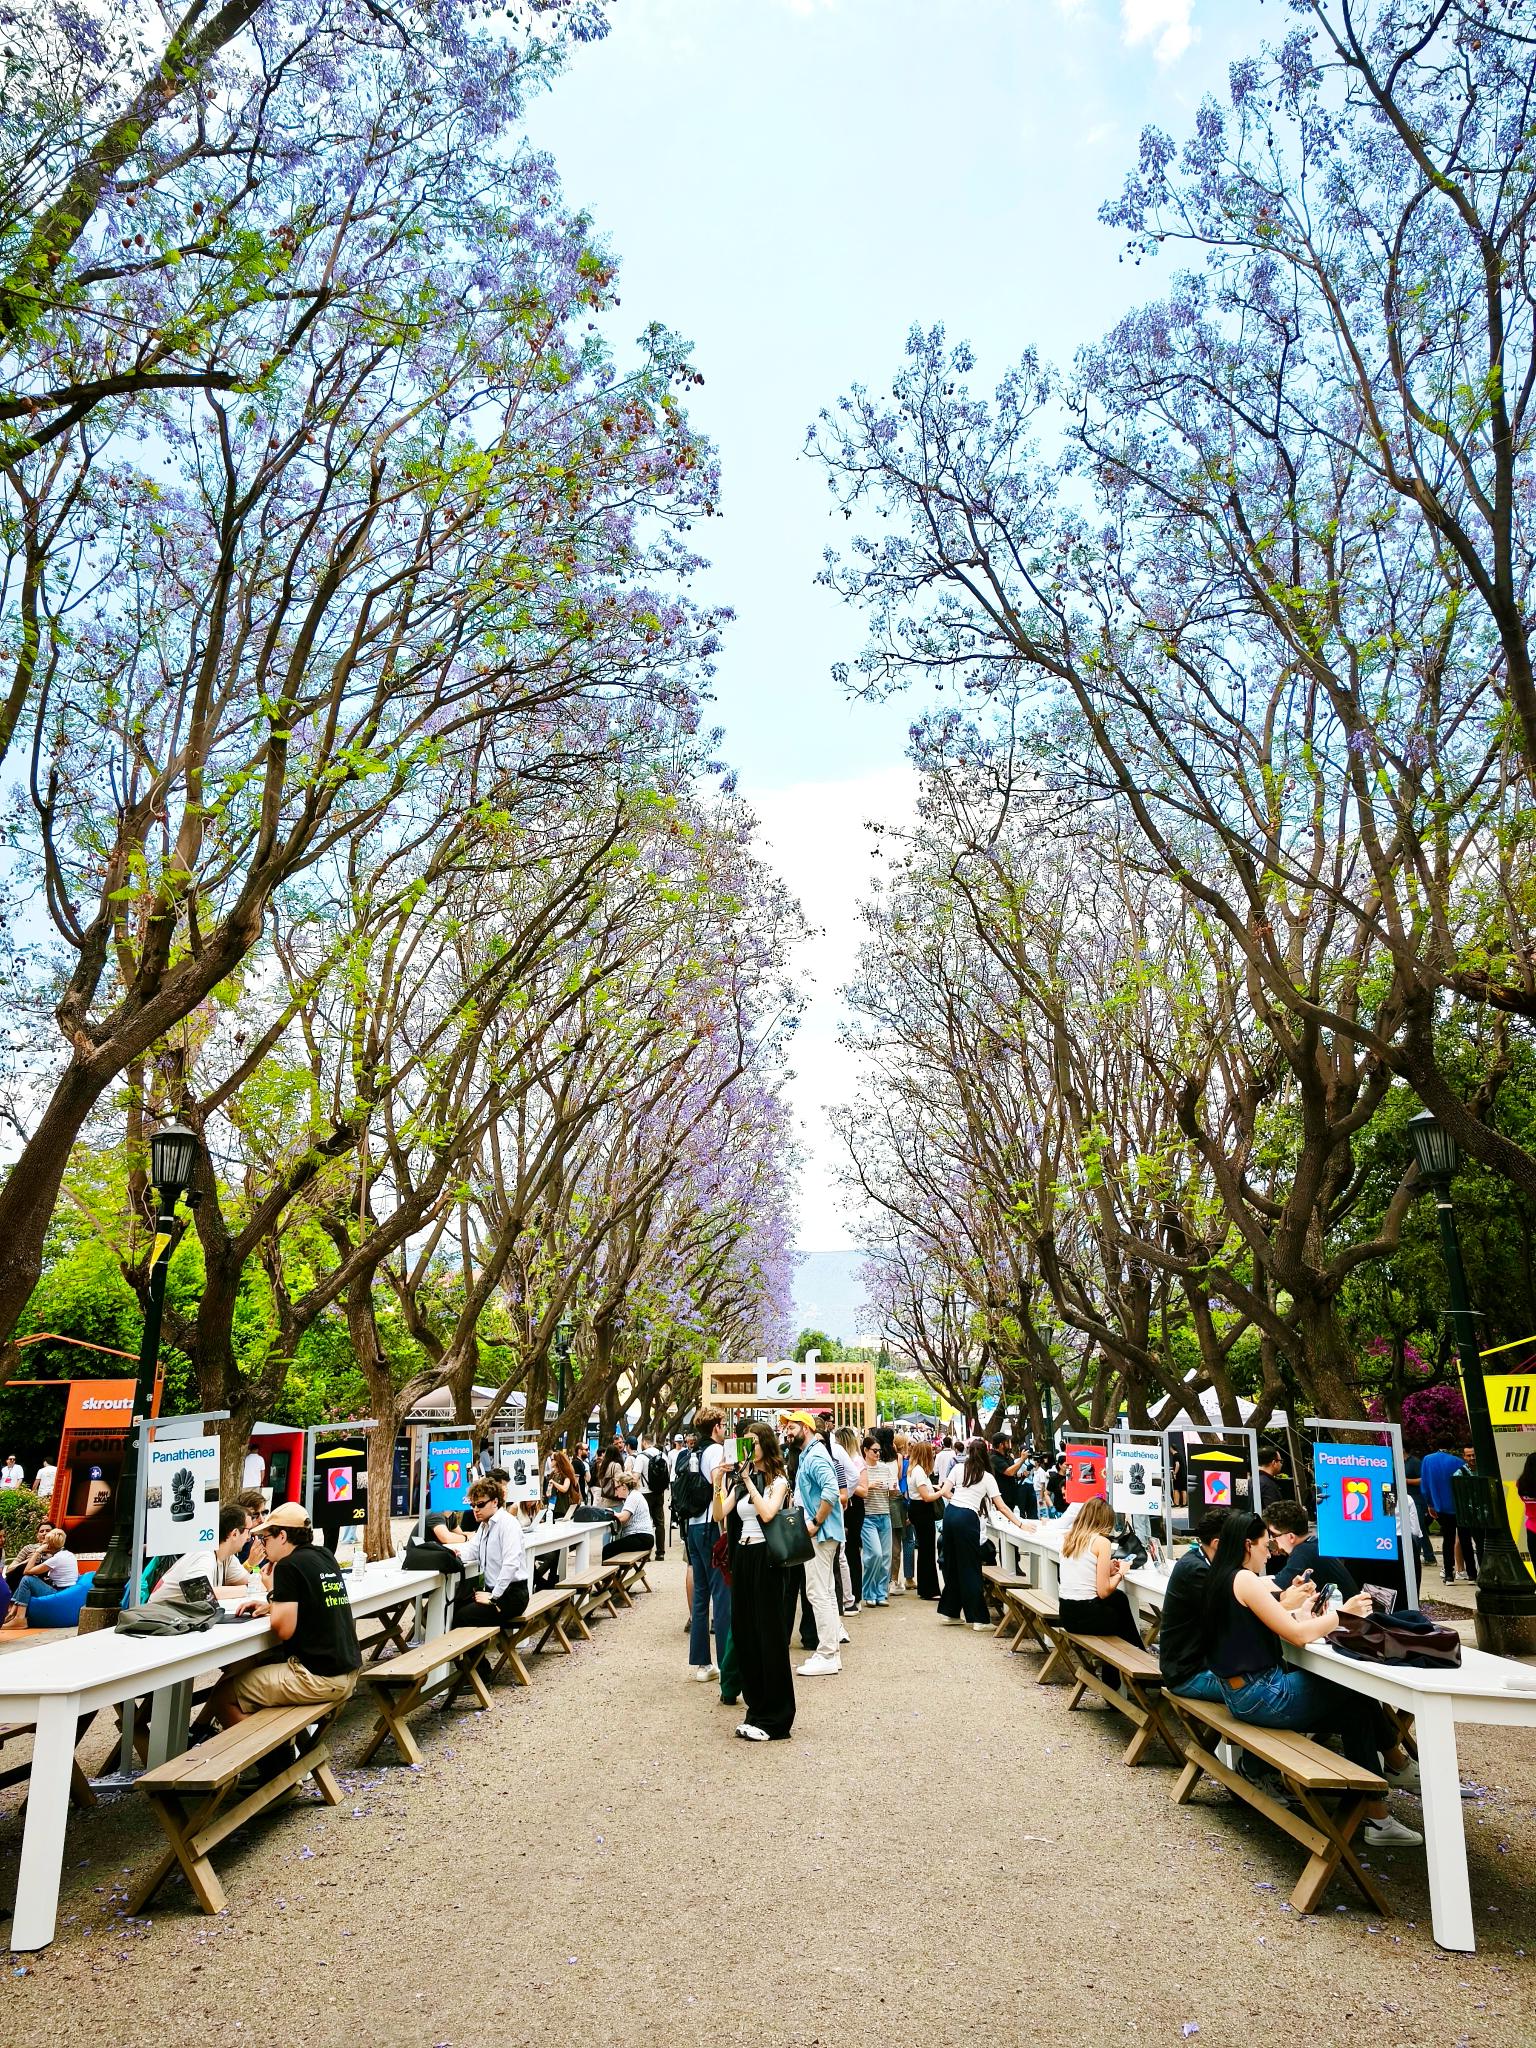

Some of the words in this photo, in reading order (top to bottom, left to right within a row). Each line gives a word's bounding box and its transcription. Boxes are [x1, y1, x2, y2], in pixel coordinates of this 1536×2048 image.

[752, 1349, 821, 1400] taf
[82, 1397, 134, 1410] skroutz
[152, 1448, 215, 1463] Panathēnea
[1318, 1452, 1388, 1468] Panathēnea
[1148, 1501, 1159, 1510] 26
[353, 1508, 366, 1519] 26
[199, 1528, 215, 1542] 26
[1375, 1537, 1393, 1550] 26
